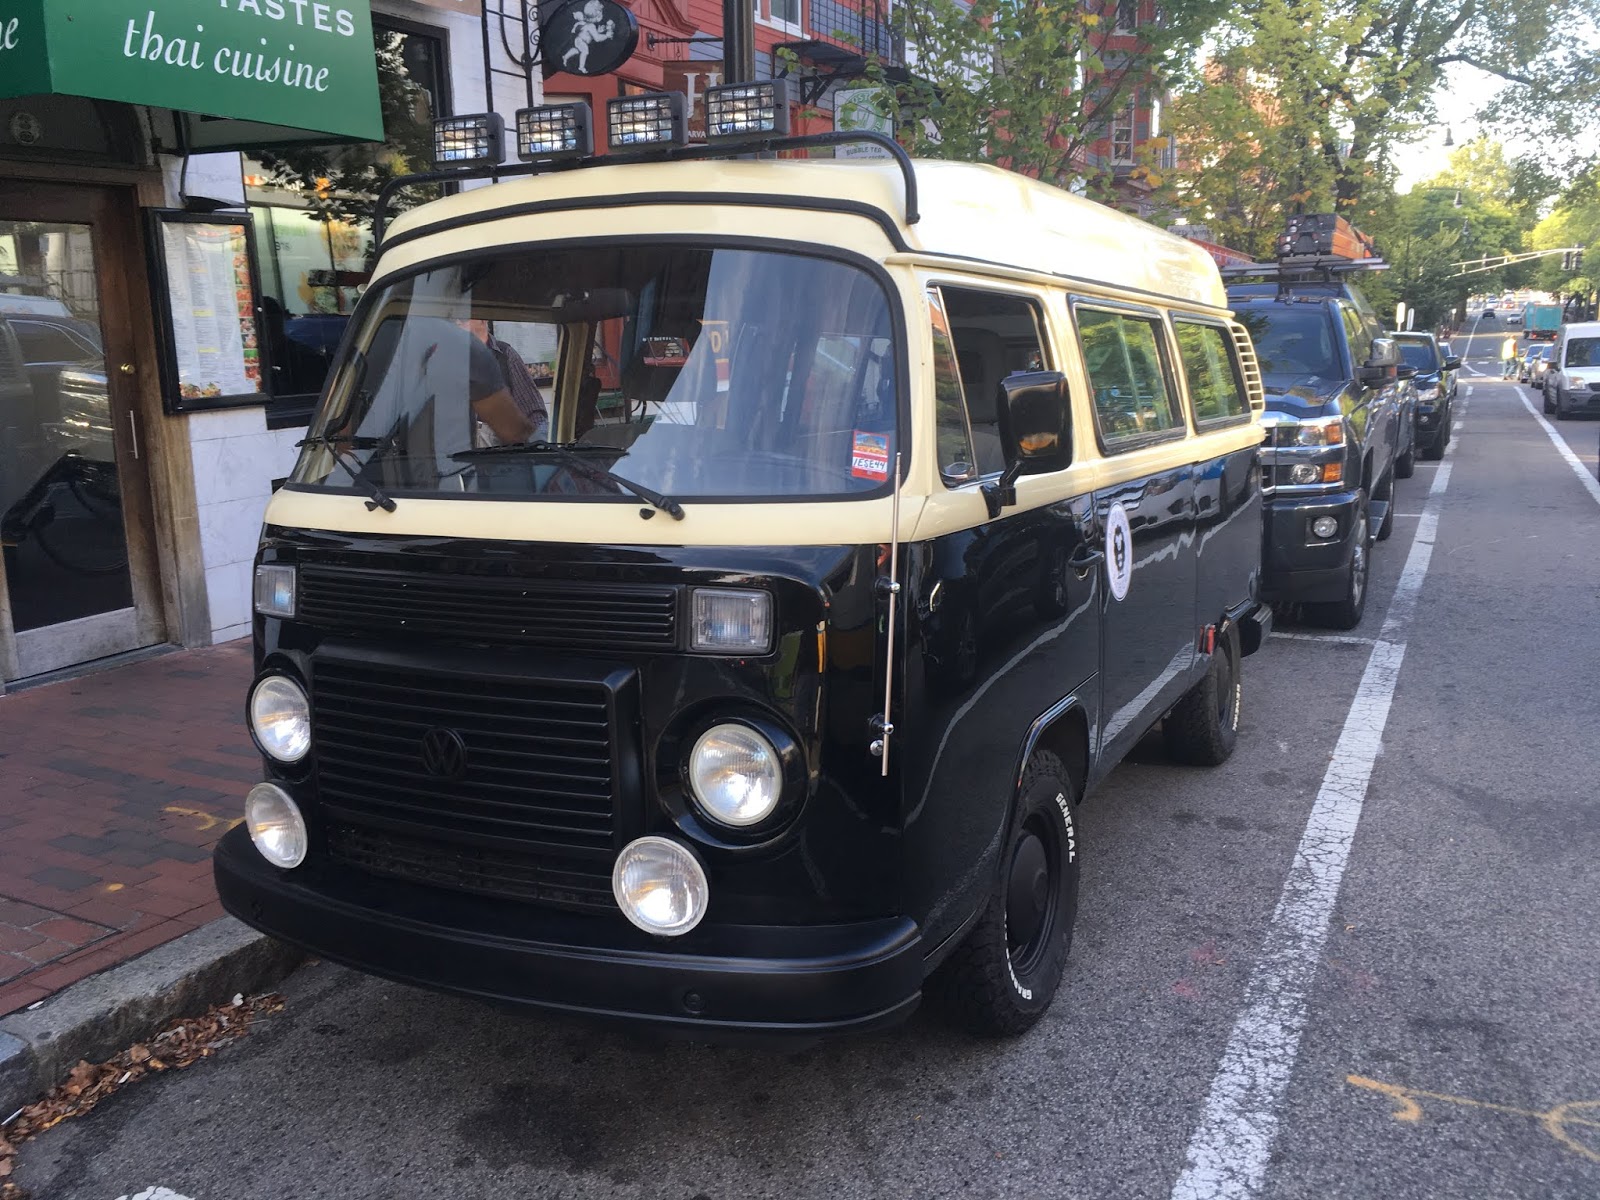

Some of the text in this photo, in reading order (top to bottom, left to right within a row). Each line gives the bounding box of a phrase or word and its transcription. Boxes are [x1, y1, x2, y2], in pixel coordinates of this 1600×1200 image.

[0, 17, 19, 50] e
[220, 0, 355, 37] ASTES
[123, 10, 330, 92] thai cuisine
[687, 130, 707, 138] ARVA
[1055, 792, 1076, 864] GENERAL
